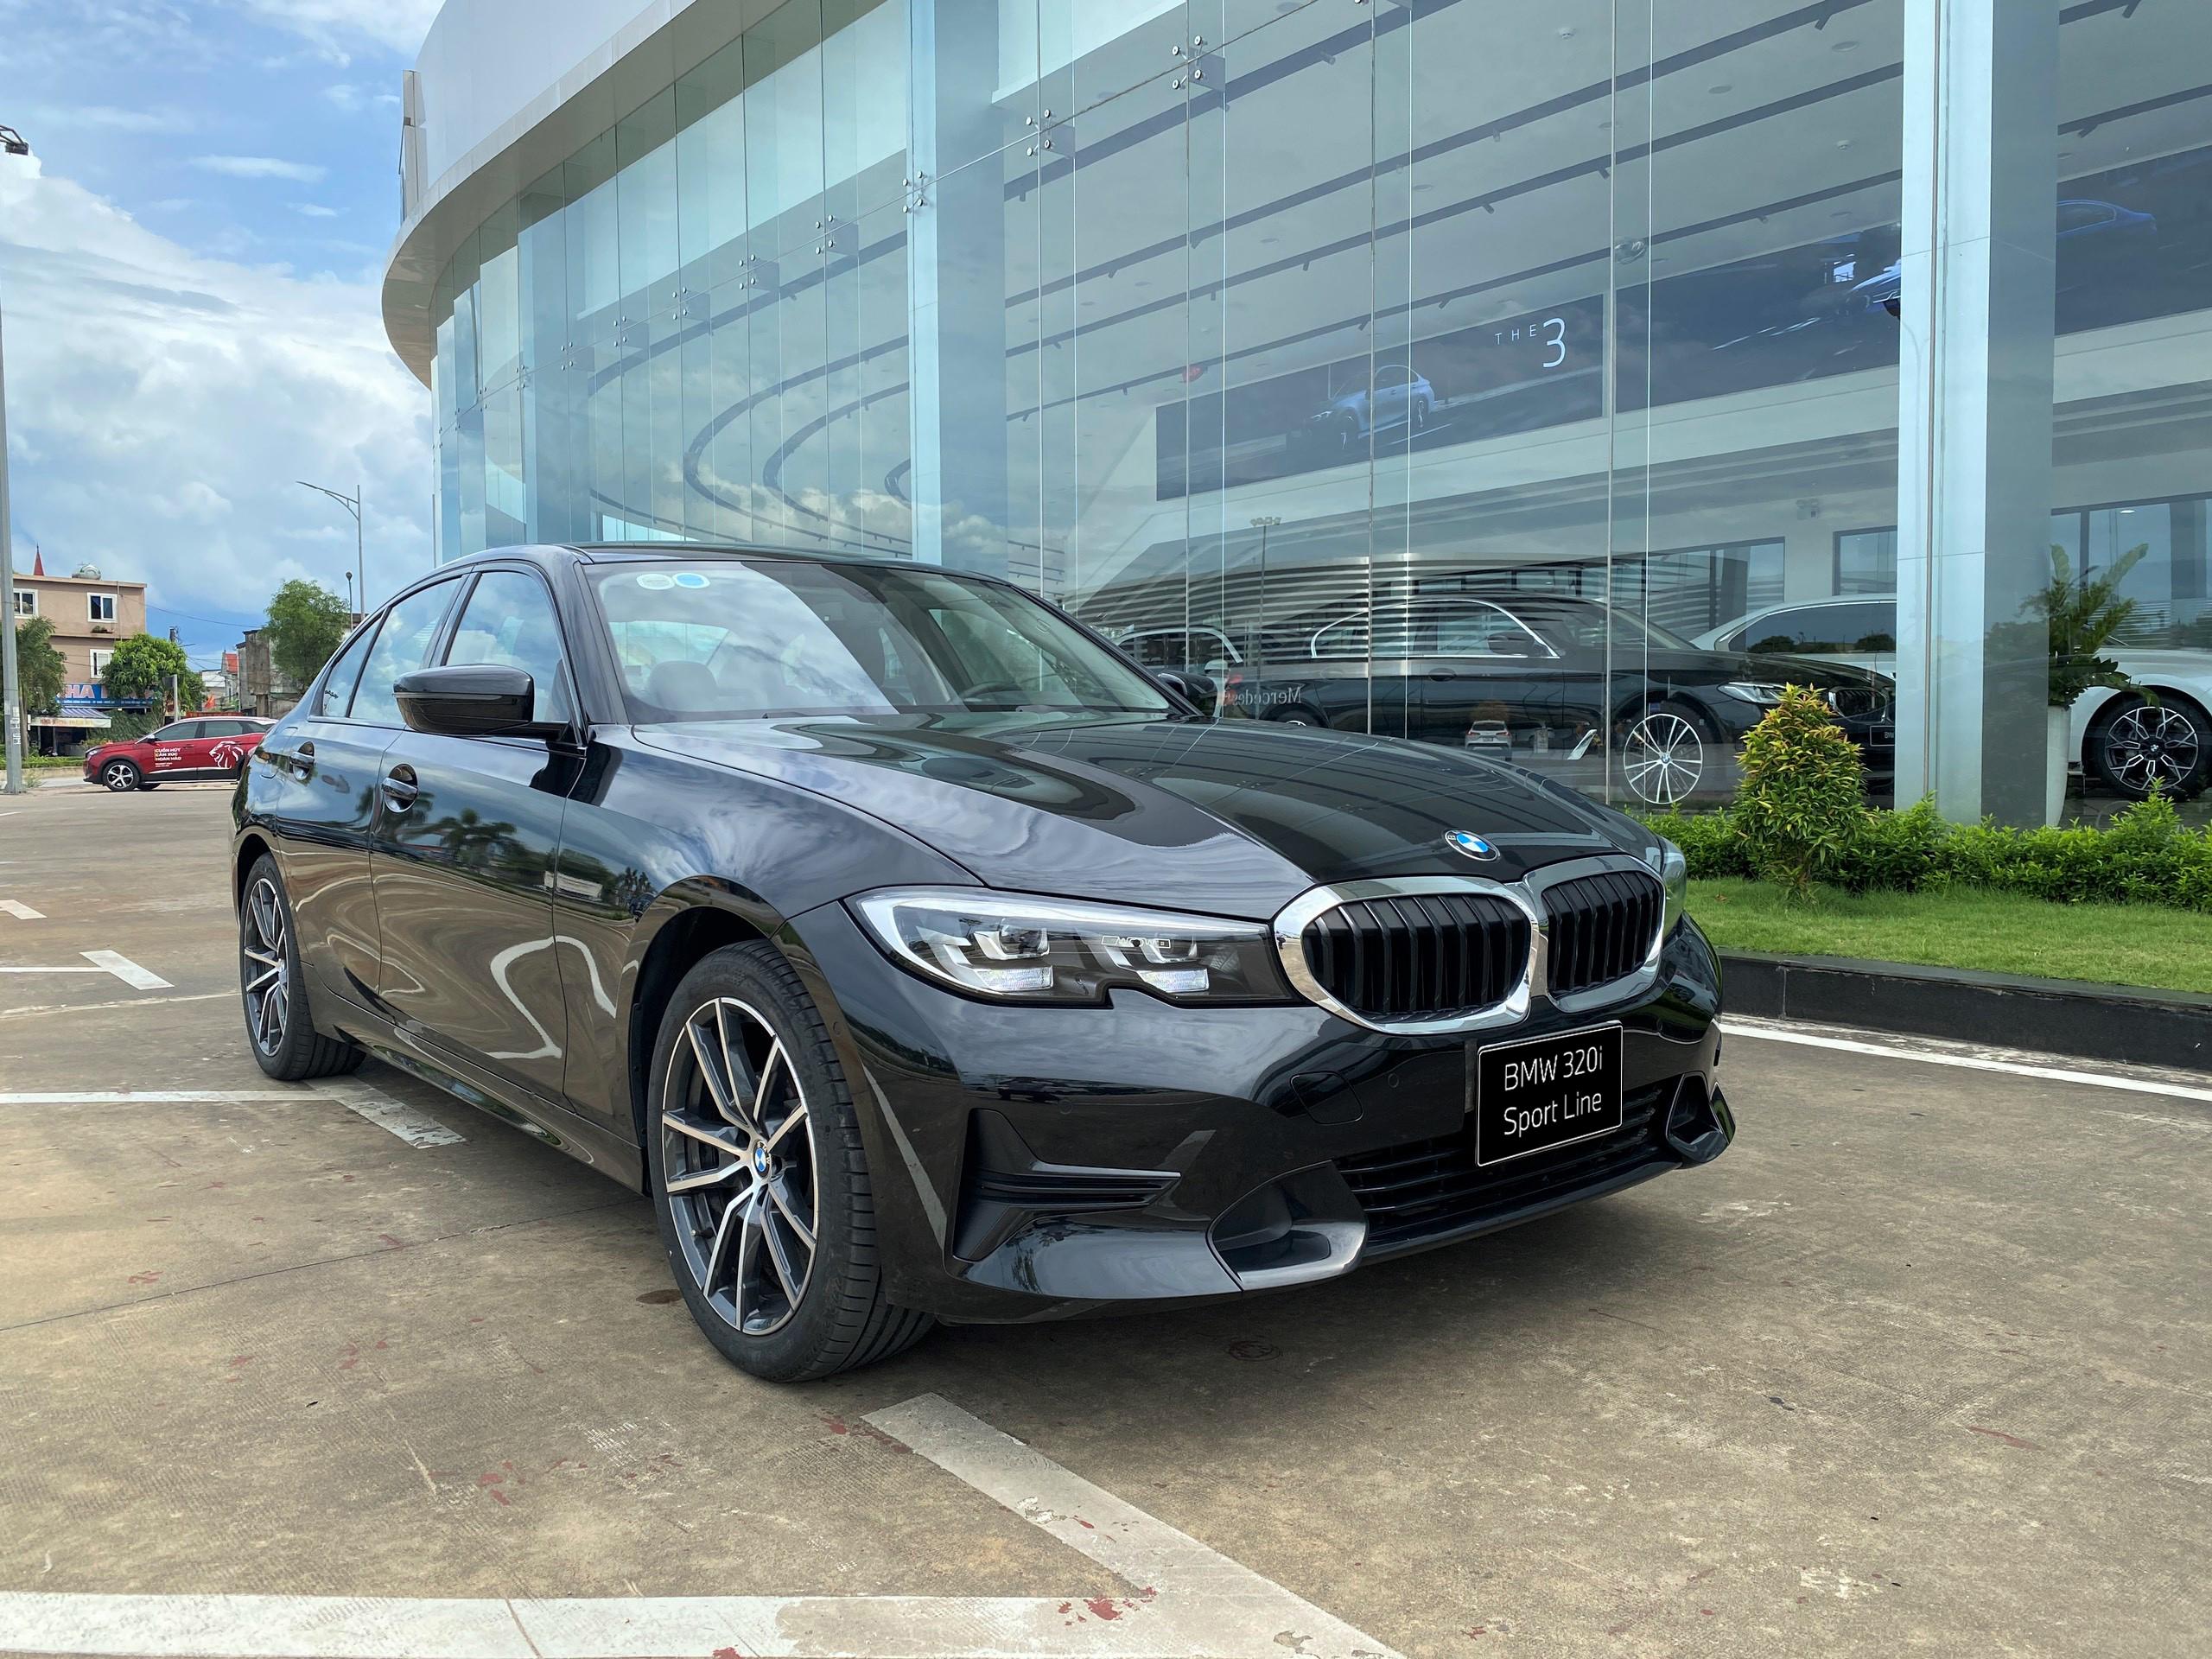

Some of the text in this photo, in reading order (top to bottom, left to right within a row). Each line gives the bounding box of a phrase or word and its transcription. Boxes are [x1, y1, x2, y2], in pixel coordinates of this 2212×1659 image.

[1495, 317, 1566, 368] THE 3
[1504, 1046, 1602, 1091] BMW 320i
[1503, 1091, 1602, 1138] Sport Line
